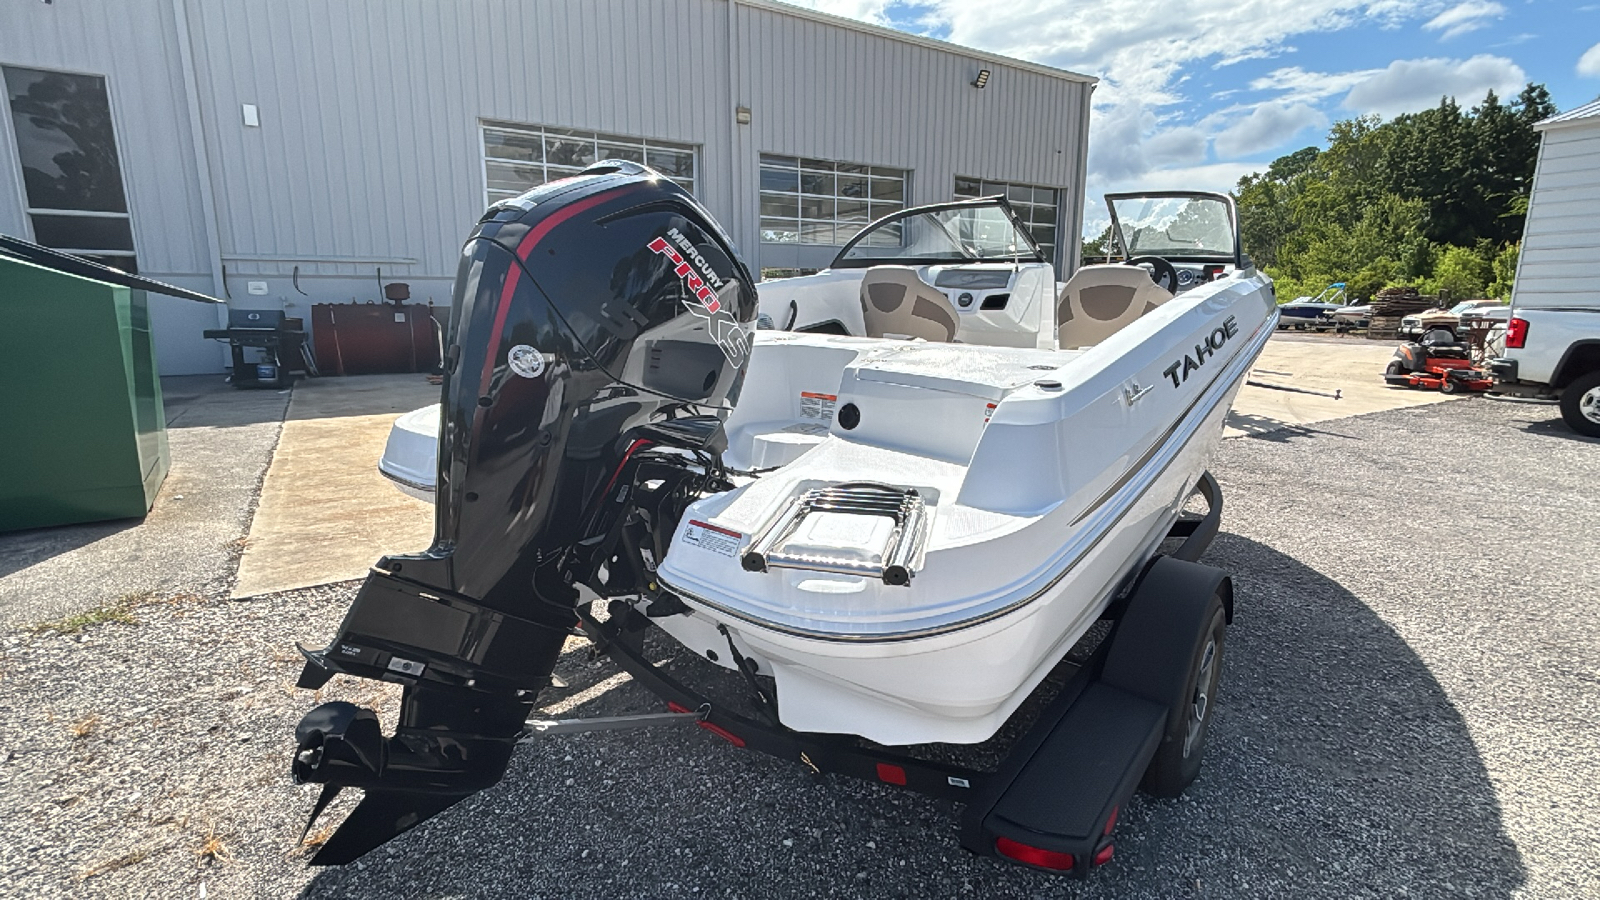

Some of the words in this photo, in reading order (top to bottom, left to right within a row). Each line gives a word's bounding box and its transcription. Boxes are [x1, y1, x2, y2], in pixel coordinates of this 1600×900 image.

[647, 237, 720, 314] PRO
[667, 228, 723, 288] MERCURY
[681, 300, 750, 369] XS
[1163, 315, 1239, 389] TAHOE
